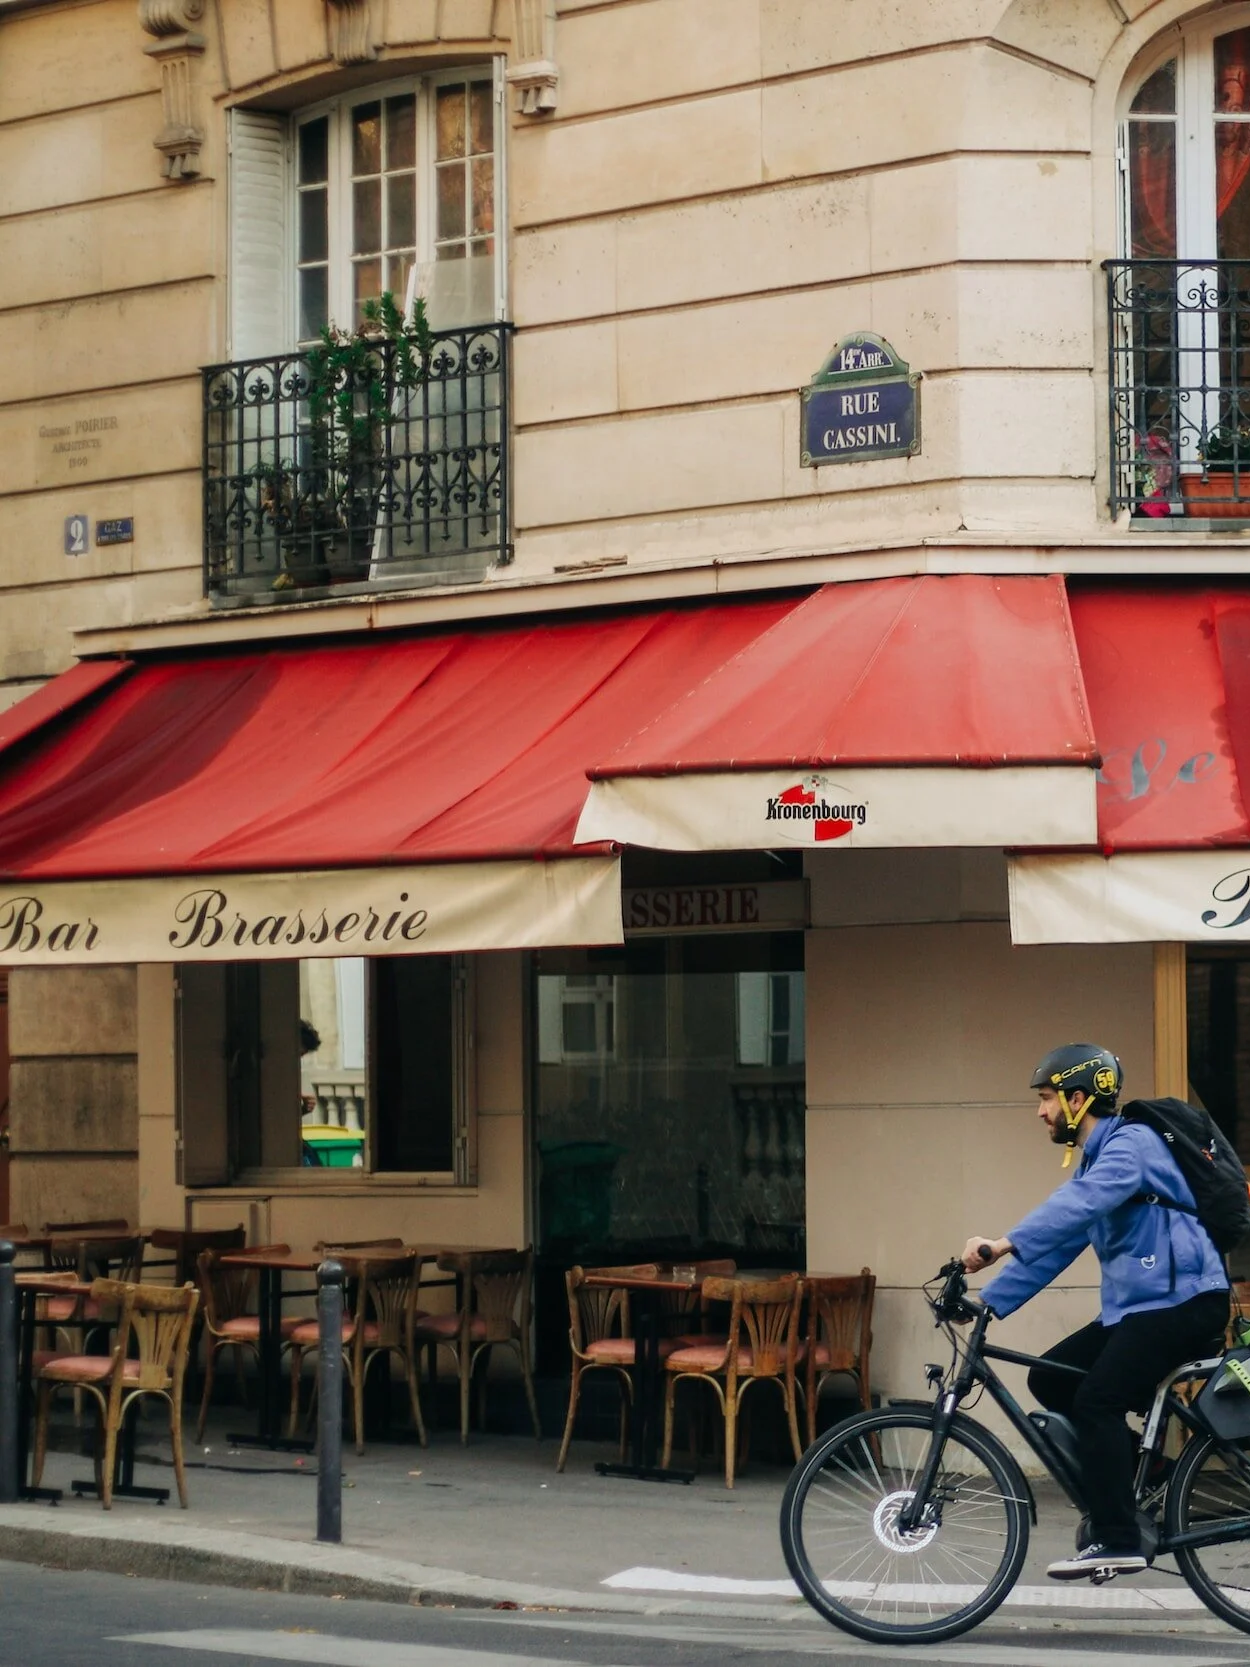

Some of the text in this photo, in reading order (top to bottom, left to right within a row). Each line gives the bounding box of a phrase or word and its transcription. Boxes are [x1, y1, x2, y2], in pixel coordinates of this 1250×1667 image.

[841, 392, 880, 416] RUE
[823, 422, 901, 450] CASSINI.
[70, 519, 84, 552] 2
[765, 798, 868, 825] Kronenbourg
[0, 889, 429, 953] Bar Brasserie
[1096, 1071, 1116, 1090] 59
